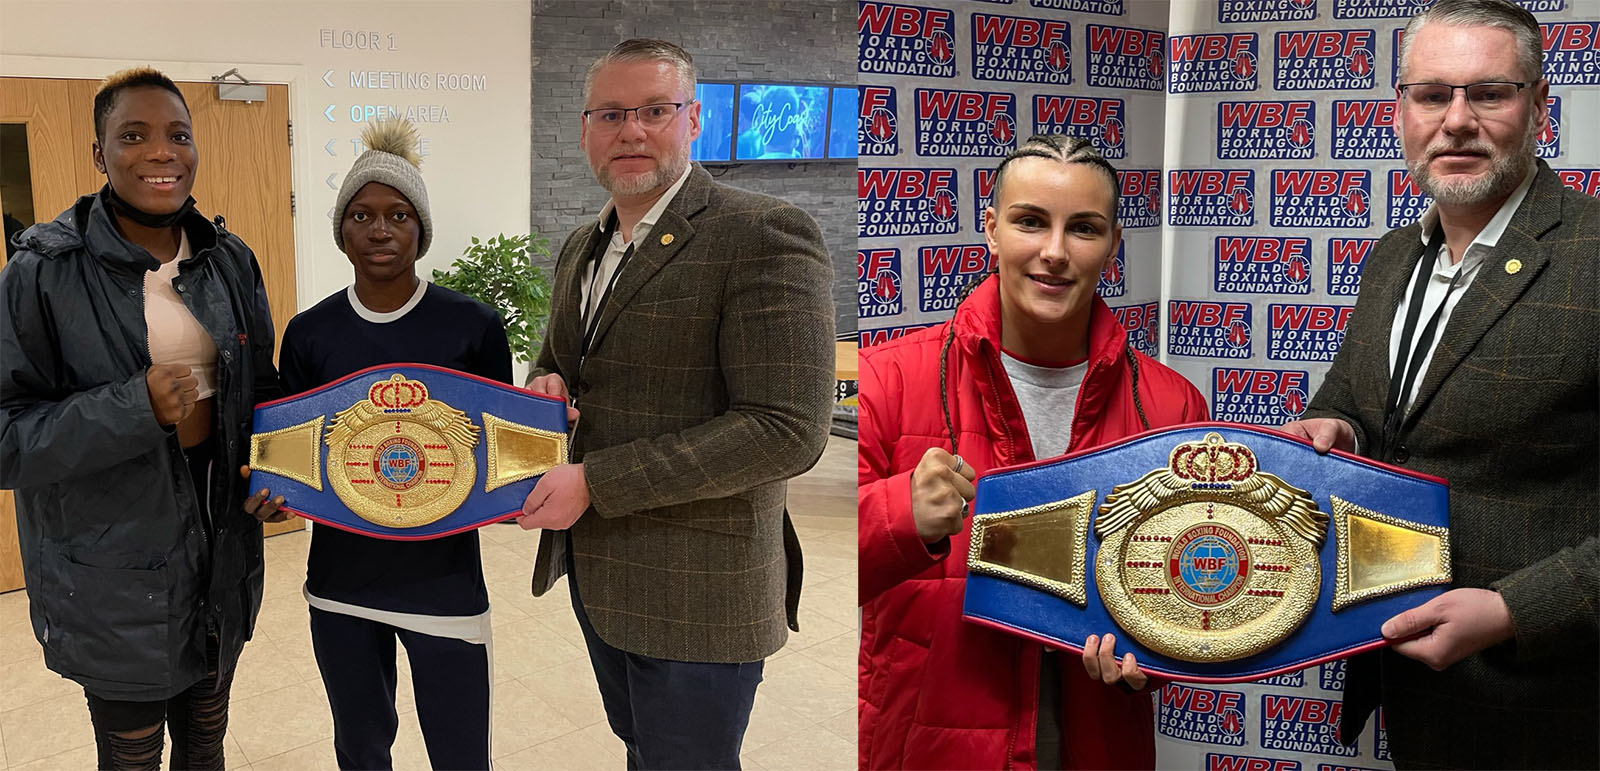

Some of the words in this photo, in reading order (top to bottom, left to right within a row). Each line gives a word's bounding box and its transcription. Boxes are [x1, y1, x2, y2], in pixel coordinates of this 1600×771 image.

[1222, 0, 1288, 12] BOXING
[1337, 6, 1425, 18] FOUNDATIO
[858, 3, 950, 39] WBF
[1222, 10, 1314, 22] FOUNDATION
[975, 15, 1066, 49] WBF
[320, 29, 381, 50] FLOOR
[387, 33, 398, 51] 1
[1090, 26, 1163, 58] WBF
[1279, 31, 1371, 59] WBF
[858, 47, 926, 63] OXING
[976, 45, 1042, 60] WORLD
[1171, 34, 1254, 63] WBF
[976, 56, 1044, 71] BOXING
[1090, 53, 1146, 67] WORLD
[1171, 60, 1229, 72] WORLD
[1278, 58, 1344, 69] WORLD
[858, 59, 953, 77] OUNDATION
[1090, 65, 1147, 78] BOXING
[1278, 68, 1345, 79] BOXING
[1546, 62, 1594, 73] XING
[350, 71, 431, 90] MEETING
[436, 74, 487, 91] ROOM
[976, 68, 1069, 84] FOUNDATION
[1090, 75, 1163, 90] FOUNDATION
[1171, 70, 1230, 83] BOXING
[1170, 80, 1255, 93] FOUNDATION
[1277, 78, 1372, 90] FOUNDATION
[919, 90, 1011, 122] WBF
[1037, 96, 1121, 126] WBF
[350, 104, 400, 123] OPEN
[406, 105, 451, 123] AREA
[1221, 102, 1311, 128] WBF
[1337, 102, 1396, 128] WB
[920, 120, 986, 133] WORLD
[1037, 124, 1099, 137] WORLD
[1221, 128, 1285, 138] WORLD
[1336, 128, 1397, 138] WORL
[920, 132, 988, 144] BOXING
[1221, 138, 1286, 148] BOXING
[920, 143, 1014, 156] FOUNDATION
[1220, 148, 1312, 158] FOUNDATION
[1335, 148, 1402, 158] FOUNDAT
[858, 170, 952, 200] WBF
[1170, 171, 1251, 196] WBF
[1275, 171, 1367, 197] WBF
[858, 199, 927, 212] WORLD
[1119, 197, 1145, 207] RLD
[1170, 196, 1226, 206] WORLD
[1274, 196, 1340, 206] WORLD
[1391, 197, 1433, 207] WOR
[1170, 205, 1227, 215] BOXING
[1273, 206, 1341, 216] BOXING
[858, 211, 929, 224] BOXING
[1117, 216, 1160, 227] NDATION
[1170, 215, 1252, 226] FOUNDATION
[1273, 216, 1367, 227] FOUNDATION
[858, 222, 956, 236] FOUNDATION
[1219, 237, 1307, 264] WBF
[1219, 262, 1281, 273] WORLD
[1218, 272, 1283, 283] BOXING
[1218, 282, 1308, 294] FOUNDATION
[1169, 301, 1248, 328] WBF
[1169, 325, 1223, 338] WORLD
[1271, 330, 1336, 341] WORLD
[1169, 335, 1224, 347] BOXING
[1271, 340, 1337, 351] BOXING
[1169, 345, 1249, 358] FOUNDATION
[1270, 350, 1338, 361] FOUNDAT
[1216, 368, 1304, 396] WBF
[1216, 393, 1279, 405] WORLD
[1216, 403, 1280, 415] BOXING
[1215, 412, 1299, 426] FOUNDATIO
[388, 458, 410, 468] WBF
[1171, 538, 1189, 560] WORLD
[1187, 526, 1214, 540] BOXING
[1214, 527, 1248, 561] FOUNDATION
[1193, 557, 1226, 571] WBF
[1173, 575, 1217, 603] INTERNATIONAL
[1217, 574, 1245, 601] CHAMPION
[1161, 684, 1241, 715] WBF
[1161, 705, 1217, 724] WORLD
[1161, 715, 1218, 733] BOXING
[1265, 720, 1328, 734] WORLD
[1160, 724, 1243, 745] FOUNDATION
[1264, 729, 1330, 743] BOXING
[1264, 739, 1355, 757] FOUNDATION
